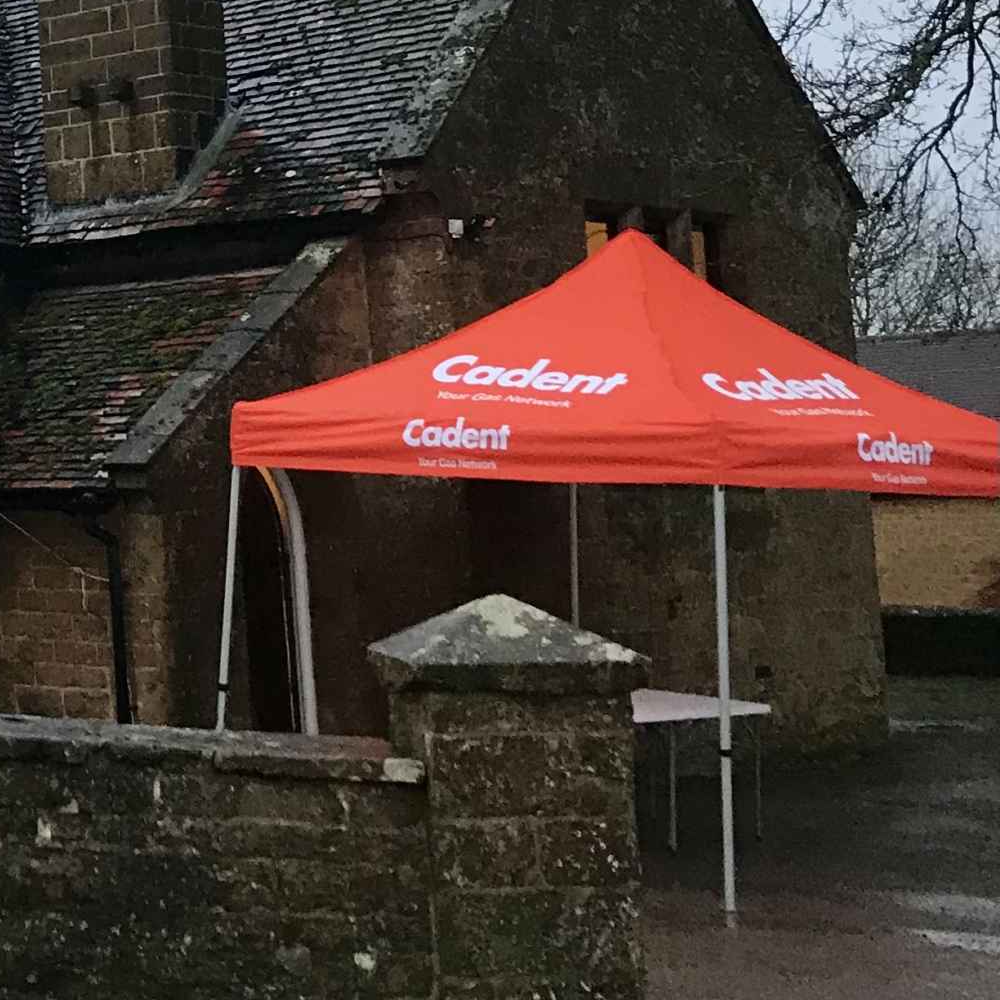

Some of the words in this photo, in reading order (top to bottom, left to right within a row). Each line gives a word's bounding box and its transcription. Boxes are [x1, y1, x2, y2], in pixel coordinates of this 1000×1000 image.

[432, 354, 628, 395] Cadent
[702, 368, 860, 401] Cadent
[437, 390, 470, 400] Your
[471, 392, 502, 401] Gas
[504, 395, 571, 408] Network
[402, 416, 510, 450] Cadent
[857, 431, 933, 465] Cadent
